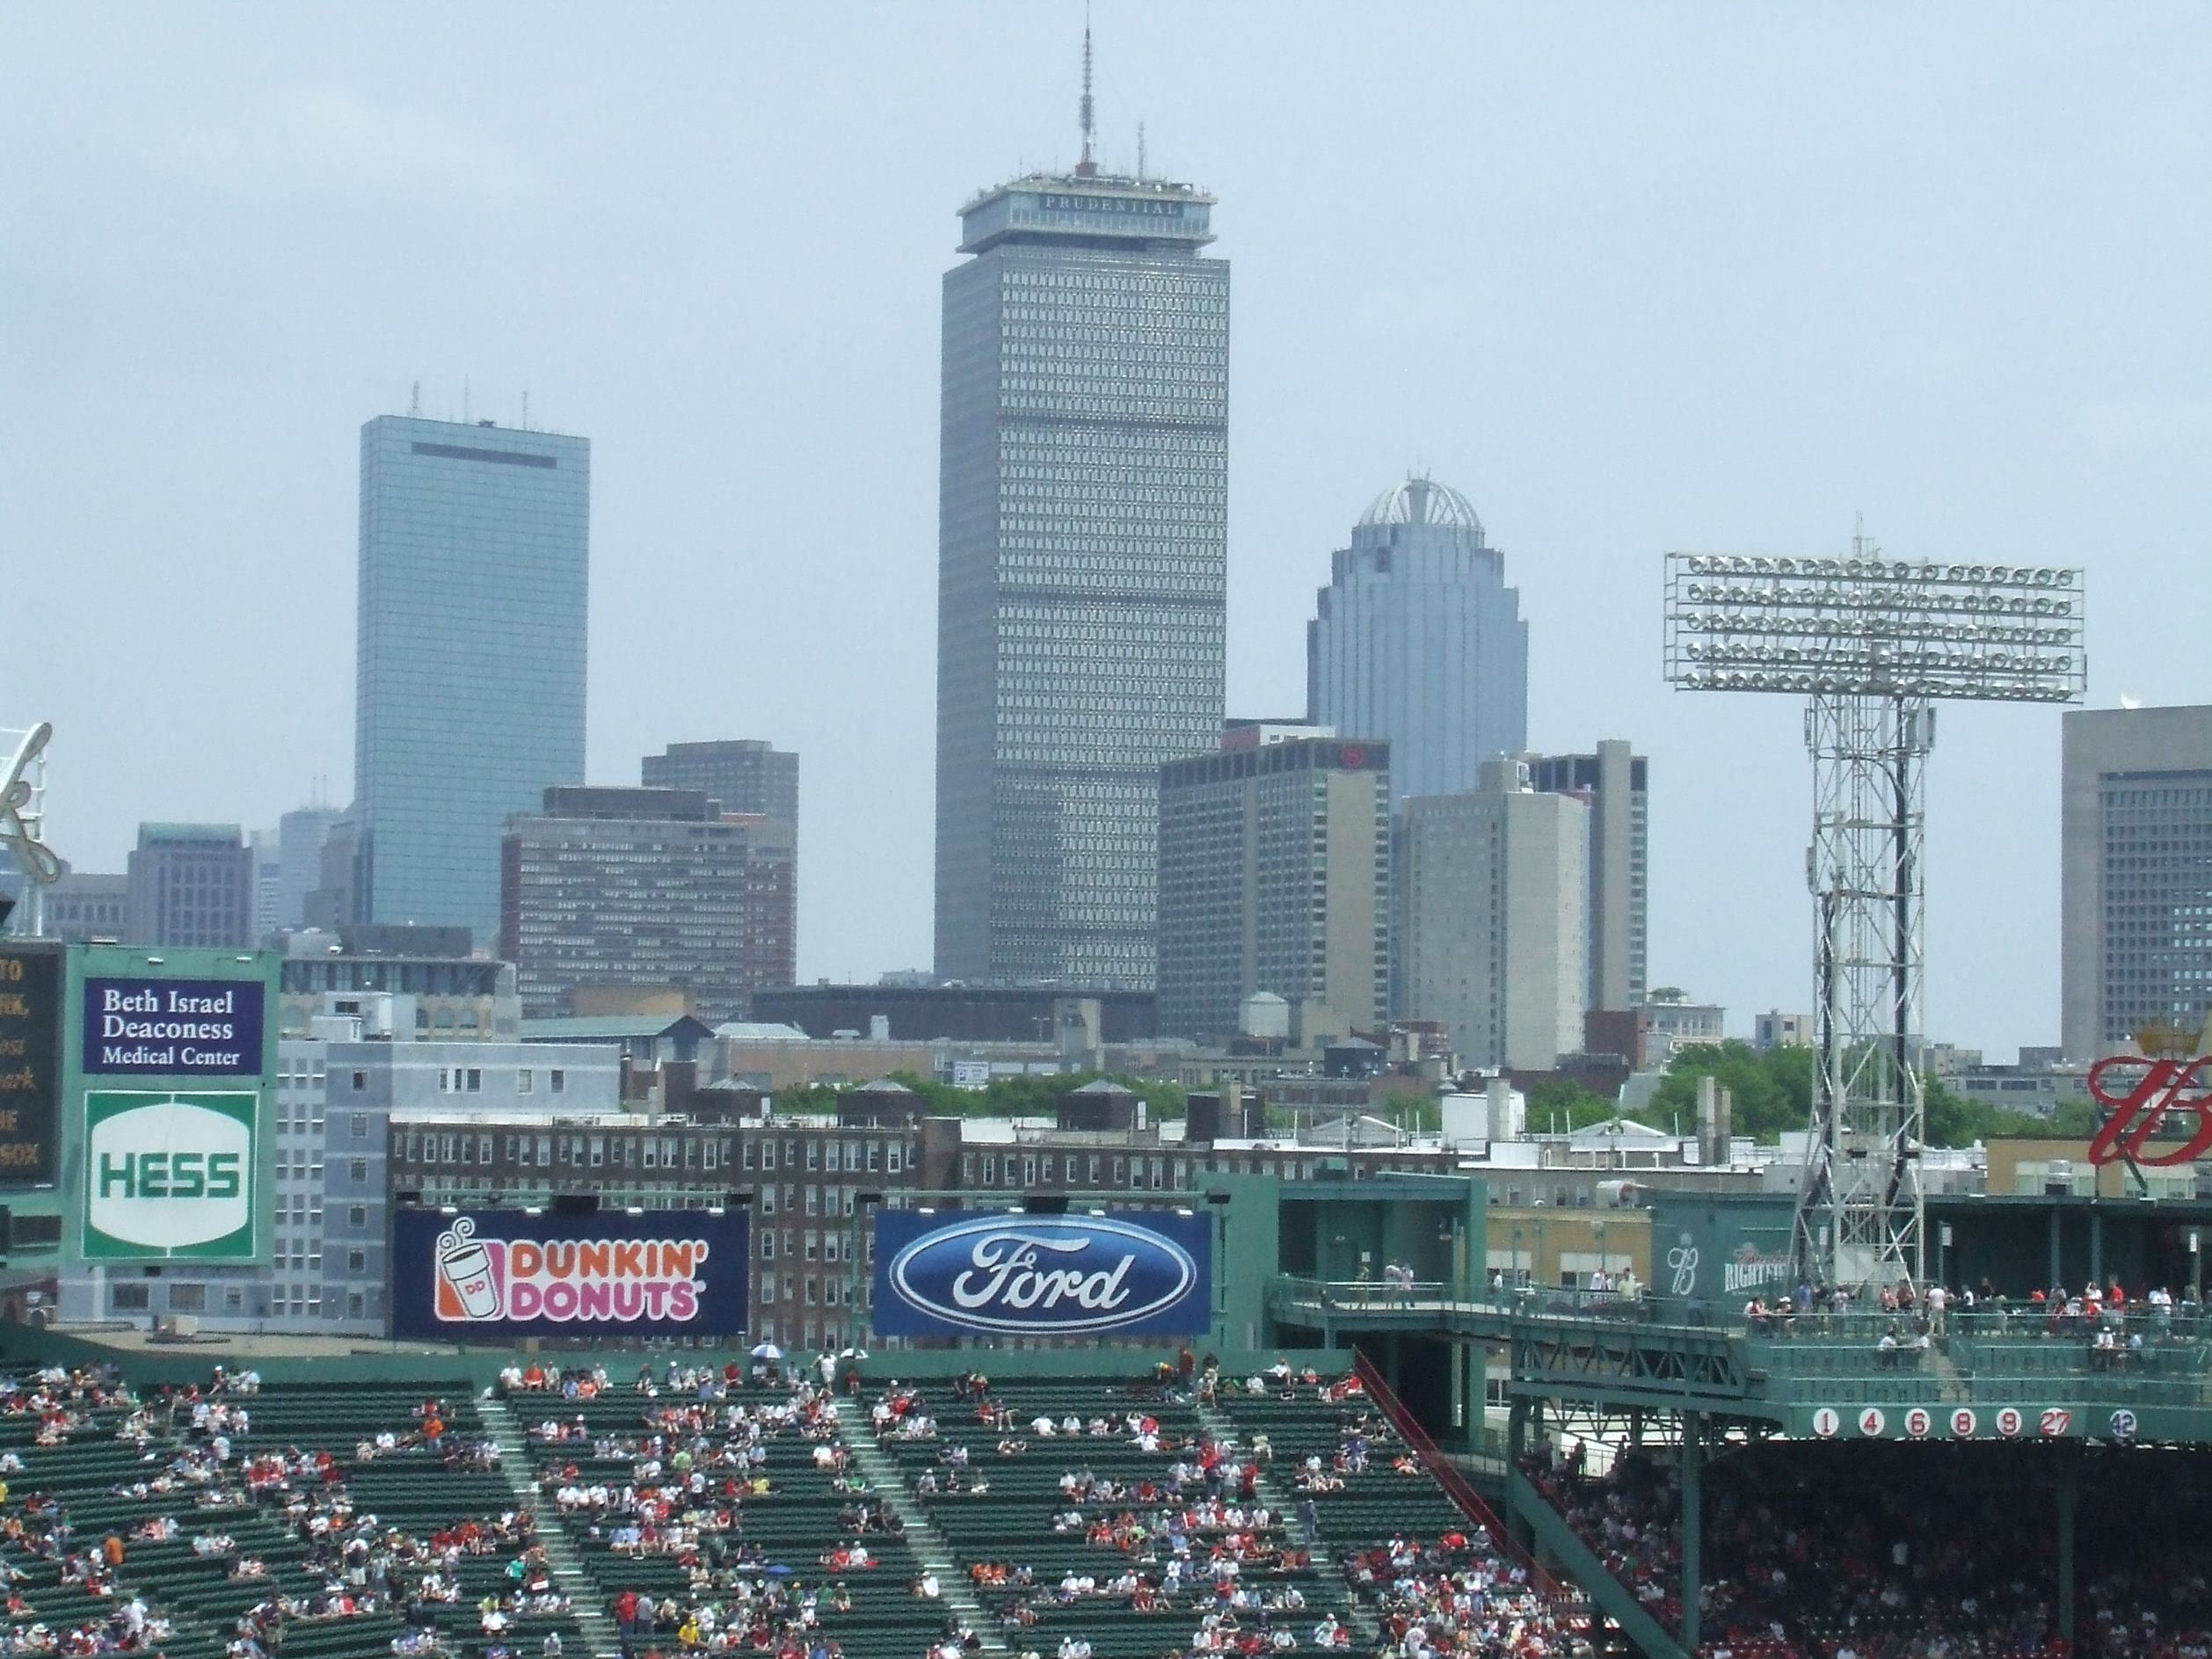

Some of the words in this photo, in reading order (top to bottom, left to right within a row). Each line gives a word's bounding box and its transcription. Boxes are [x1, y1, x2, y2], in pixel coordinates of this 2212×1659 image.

[1045, 194, 1178, 215] PRUDENTIAL
[103, 989, 158, 1013] Beth
[169, 991, 233, 1015] Israel
[103, 1015, 233, 1040] Deaconess
[102, 1046, 174, 1065] Medical
[181, 1047, 240, 1066] Center
[100, 1153, 240, 1198] HESS
[511, 1241, 708, 1279] DUNKIN'
[952, 1233, 1136, 1309] Ford
[465, 1280, 485, 1295] DD
[510, 1281, 696, 1318] DONUTS
[1821, 1412, 1830, 1433] 1
[1863, 1411, 1878, 1433] 4
[1910, 1412, 1925, 1434] 6
[1956, 1412, 1971, 1434] 8
[2002, 1412, 2017, 1433] 9
[2040, 1412, 2071, 1435] 27
[2111, 1412, 2134, 1433] 42
